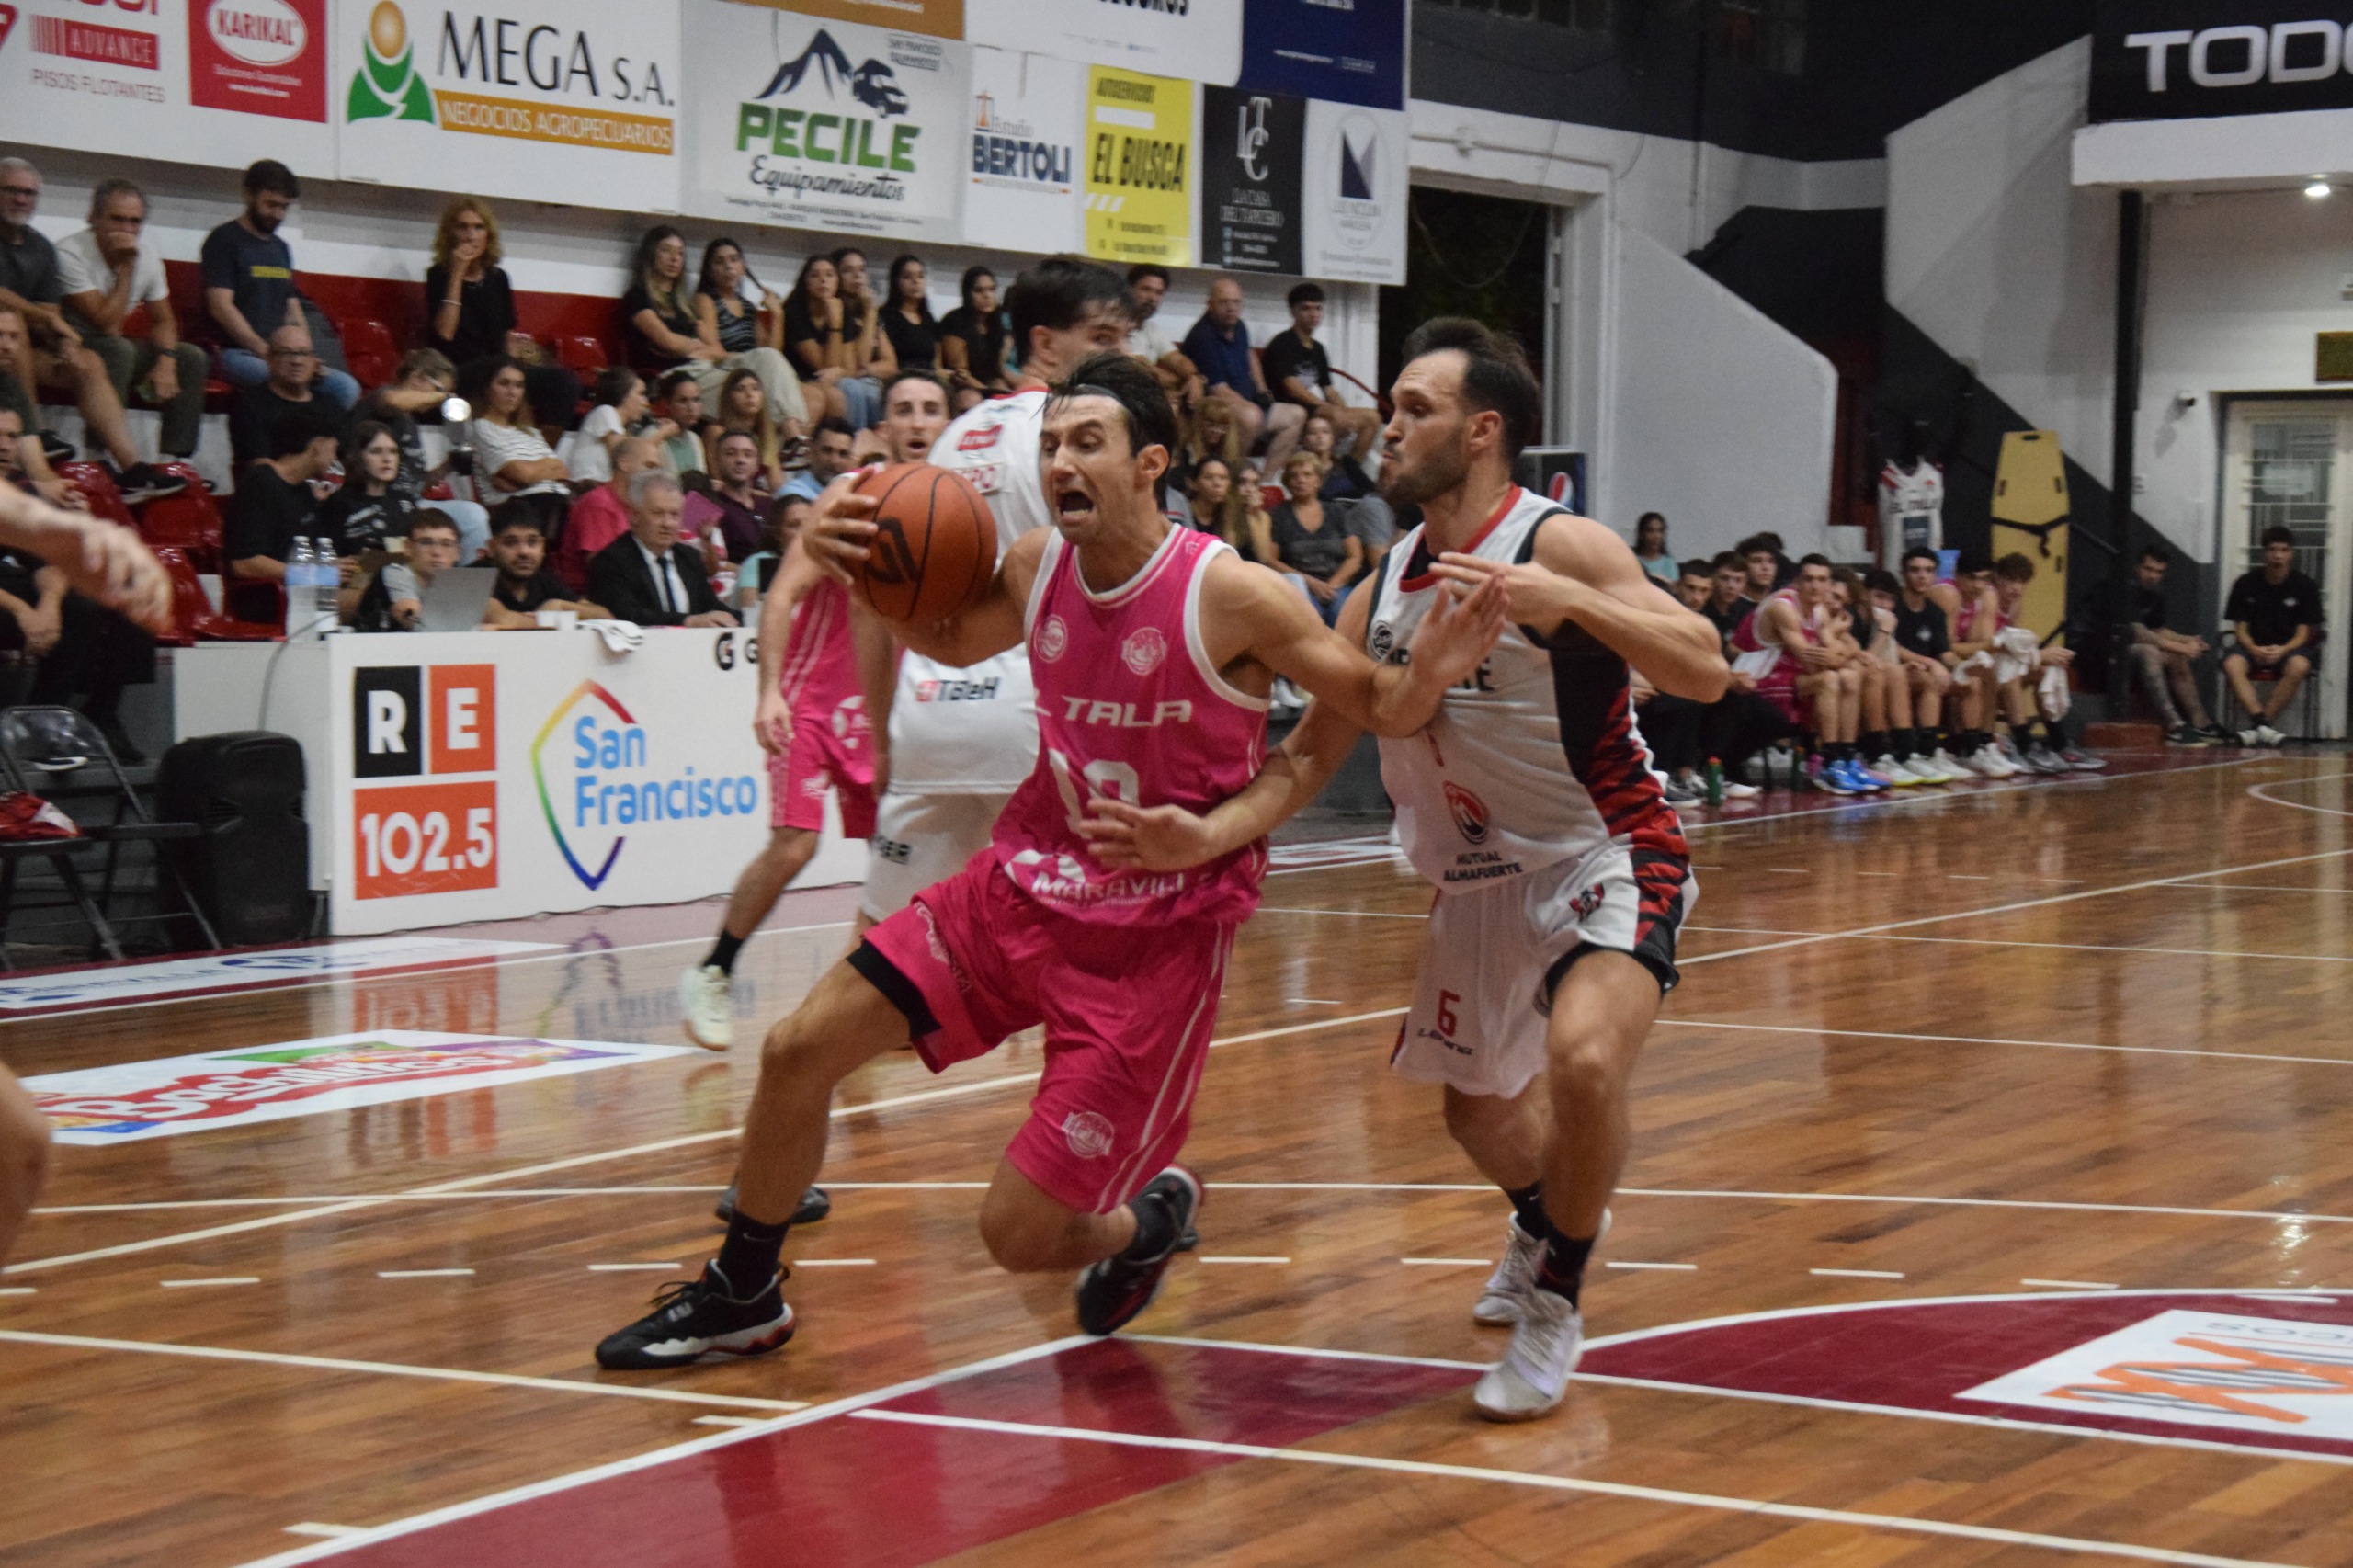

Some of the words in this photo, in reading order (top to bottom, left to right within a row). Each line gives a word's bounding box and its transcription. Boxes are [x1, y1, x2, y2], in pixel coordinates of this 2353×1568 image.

[217, 9, 295, 46] KARIKAL
[32, 69, 79, 91] PISOS
[437, 10, 599, 97] MEGA
[613, 57, 675, 107] S.A.
[442, 99, 532, 133] NEGOCIOS
[536, 111, 673, 149] AGROPECUARIOS
[736, 102, 922, 173] PECILE
[748, 154, 904, 201] Equipamientos
[972, 133, 1073, 185] BERTOLI
[1093, 133, 1115, 184] EL
[1062, 695, 1192, 727] TALA
[574, 715, 646, 770] San
[576, 766, 759, 828] Francisco
[360, 807, 494, 877] 102.5
[1456, 851, 1503, 866] MUTUAL
[1442, 862, 1523, 881] ALMAFUERTE
[1437, 989, 1460, 1037] 6
